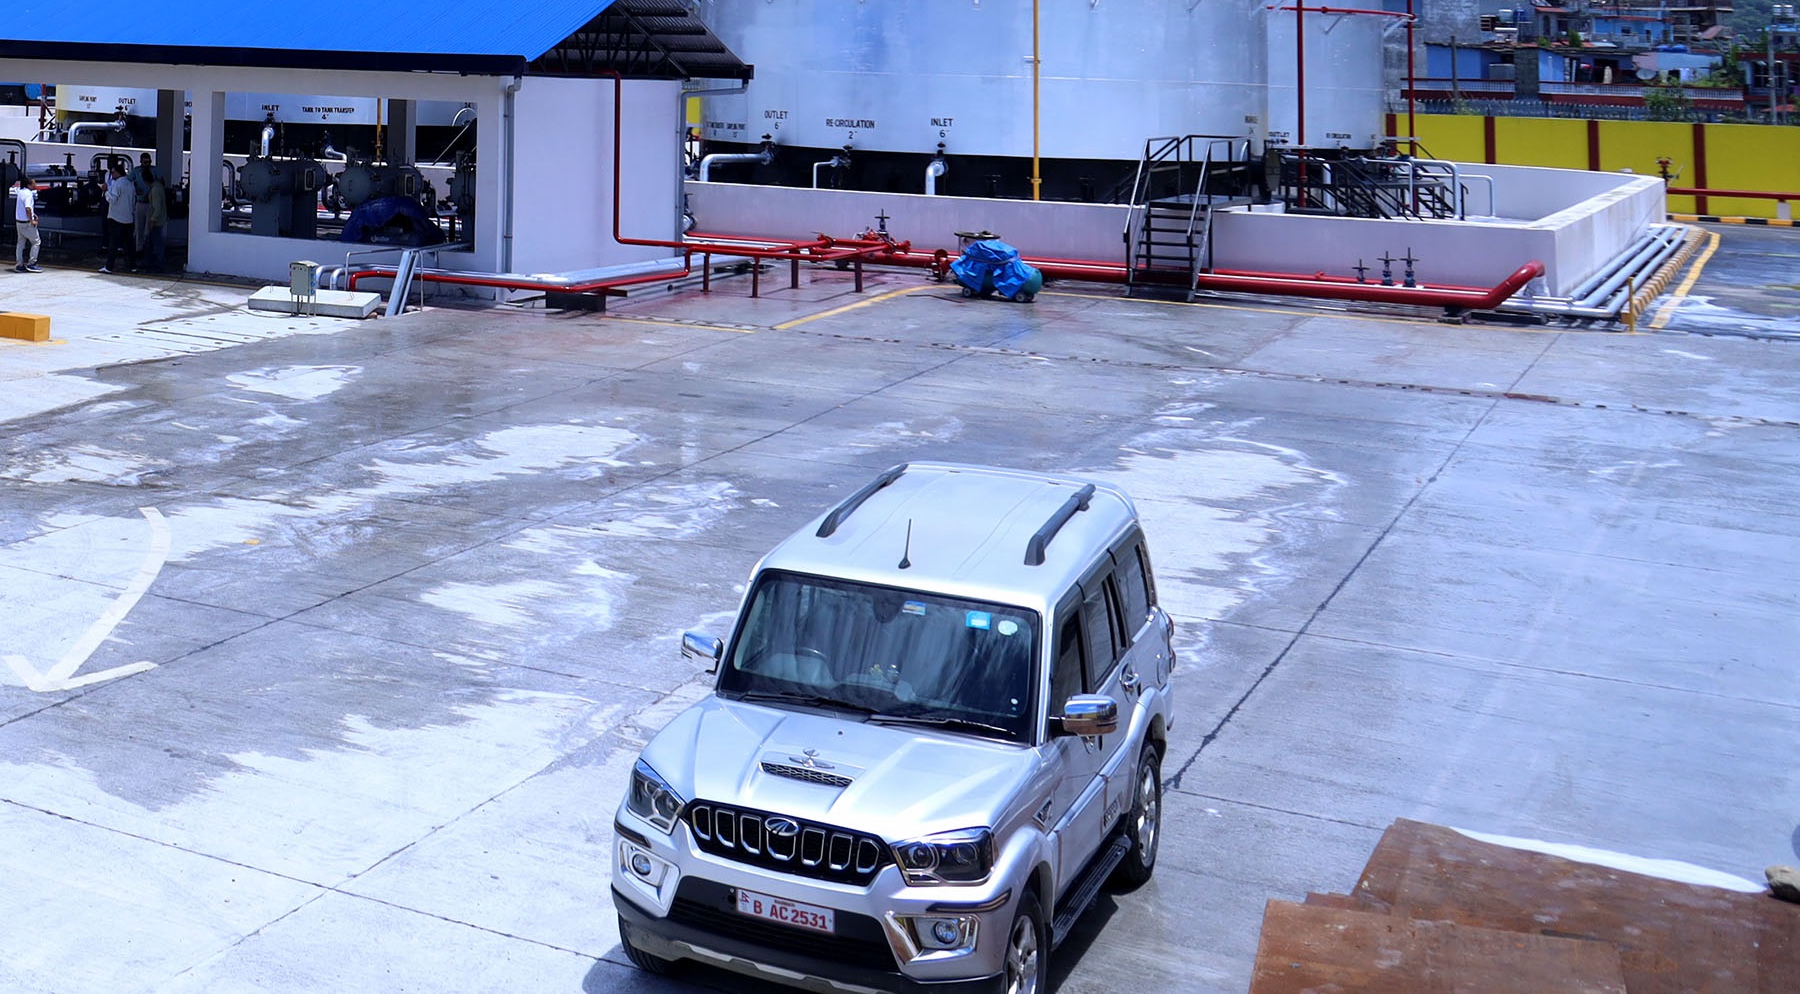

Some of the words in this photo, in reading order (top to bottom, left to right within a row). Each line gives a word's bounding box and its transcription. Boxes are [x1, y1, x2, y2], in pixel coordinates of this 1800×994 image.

[262, 104, 279, 112] INLET
[764, 110, 788, 119] OUTLET
[930, 117, 953, 127] INLET
[753, 900, 763, 914] B
[791, 909, 828, 929] 2531
